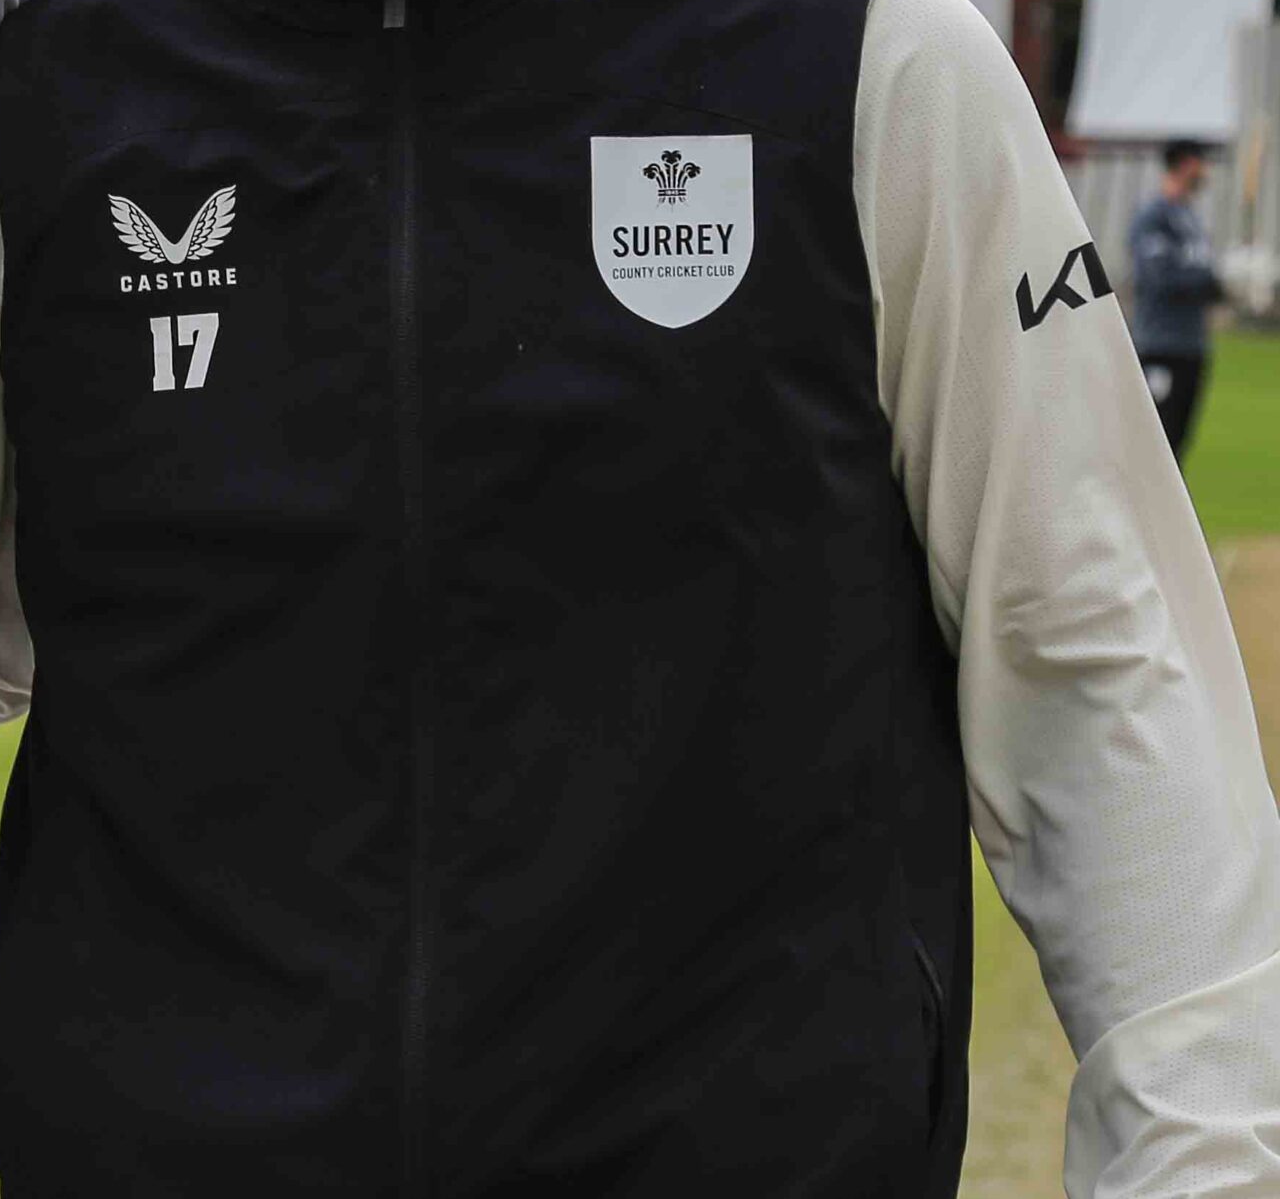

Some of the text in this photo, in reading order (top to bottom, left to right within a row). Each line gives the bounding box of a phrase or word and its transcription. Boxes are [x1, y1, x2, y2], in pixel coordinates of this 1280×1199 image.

[611, 223, 735, 258] SURREY
[120, 267, 237, 293] CASTORE
[612, 264, 736, 280] COUNTY CRICKET CLUB
[1015, 241, 1115, 333] KI
[149, 312, 220, 392] 17
